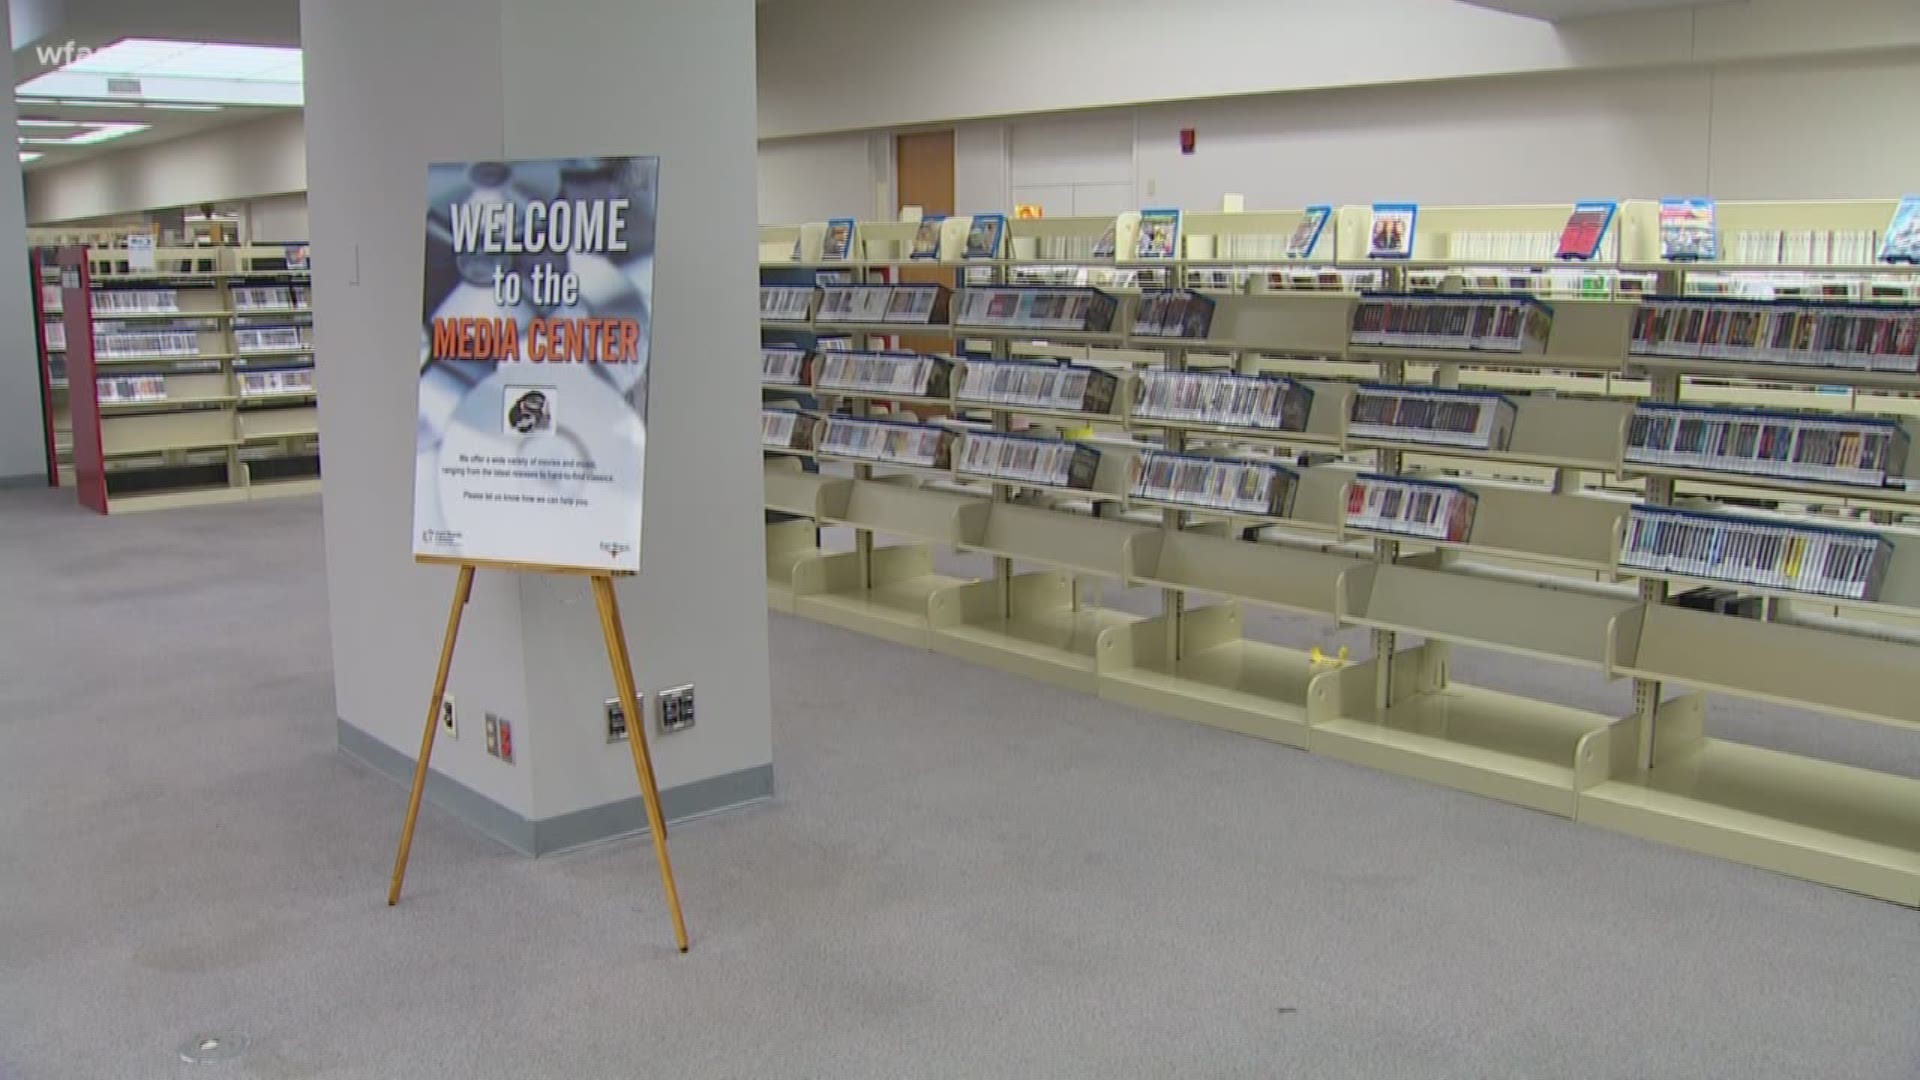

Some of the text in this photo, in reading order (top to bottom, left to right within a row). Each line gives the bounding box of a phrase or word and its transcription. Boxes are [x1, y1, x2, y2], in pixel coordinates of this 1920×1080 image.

[450, 198, 629, 253] WELCOME
[493, 262, 579, 306] to the
[432, 317, 640, 363] MEDIA CENTER
